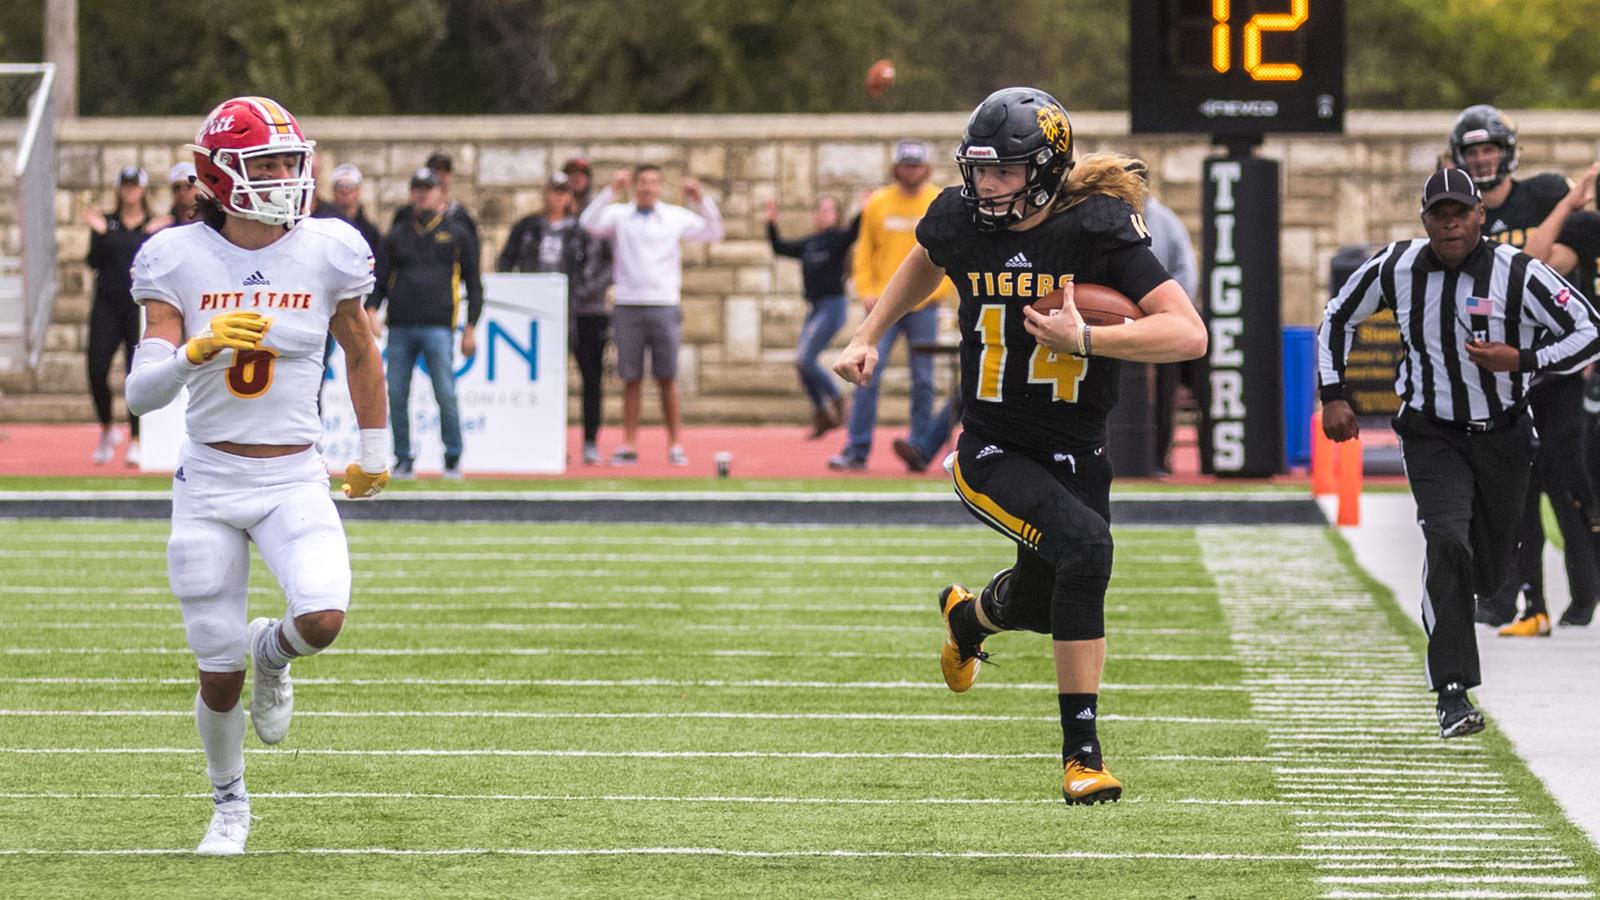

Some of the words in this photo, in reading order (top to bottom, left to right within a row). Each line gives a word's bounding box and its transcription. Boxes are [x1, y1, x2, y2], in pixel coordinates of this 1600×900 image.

[1212, 0, 1309, 81] 12
[200, 293, 243, 310] PITT
[252, 291, 312, 309] STATE
[242, 278, 271, 286] adidas
[1210, 163, 1246, 472] TIGERS
[974, 303, 1089, 404] 14
